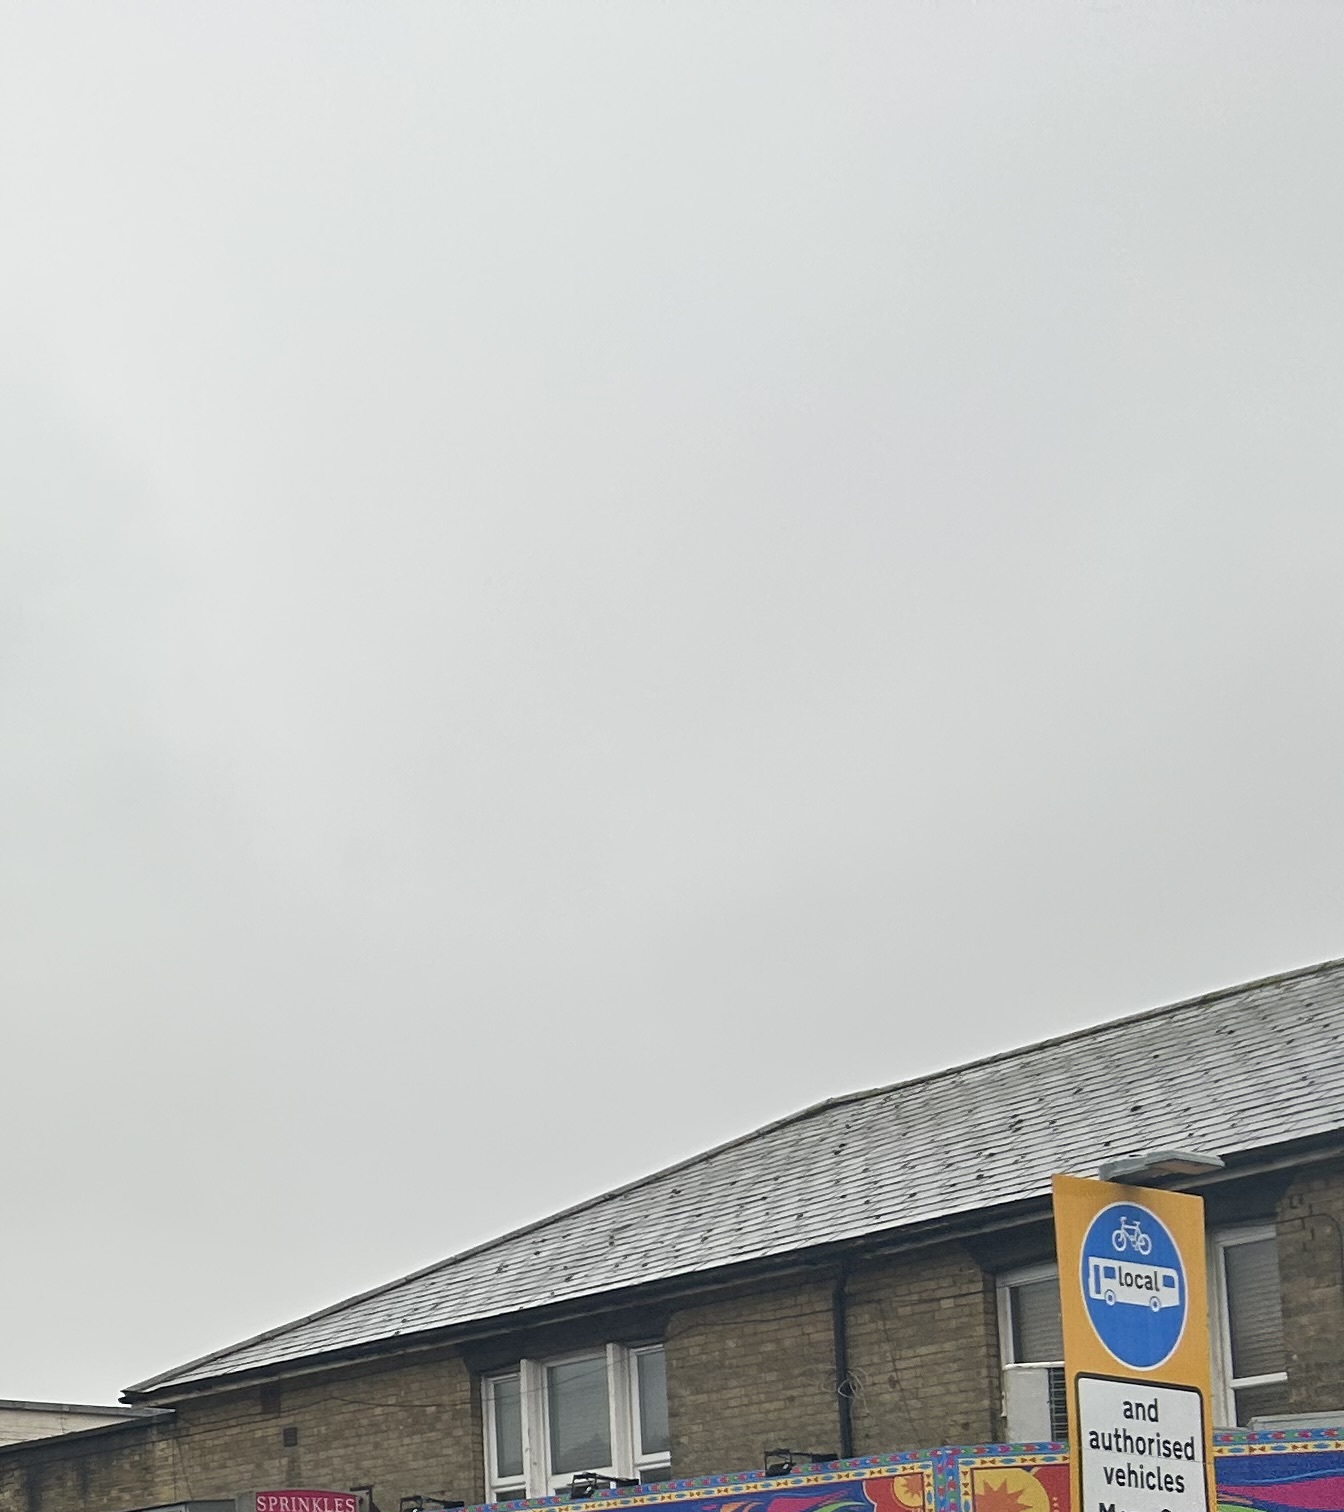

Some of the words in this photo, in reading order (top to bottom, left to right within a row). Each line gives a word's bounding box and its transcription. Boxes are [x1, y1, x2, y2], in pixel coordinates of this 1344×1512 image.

[1118, 1266, 1160, 1291] local
[1122, 1398, 1159, 1422] and
[1088, 1428, 1195, 1460] authorised
[1103, 1462, 1185, 1493] vehicles
